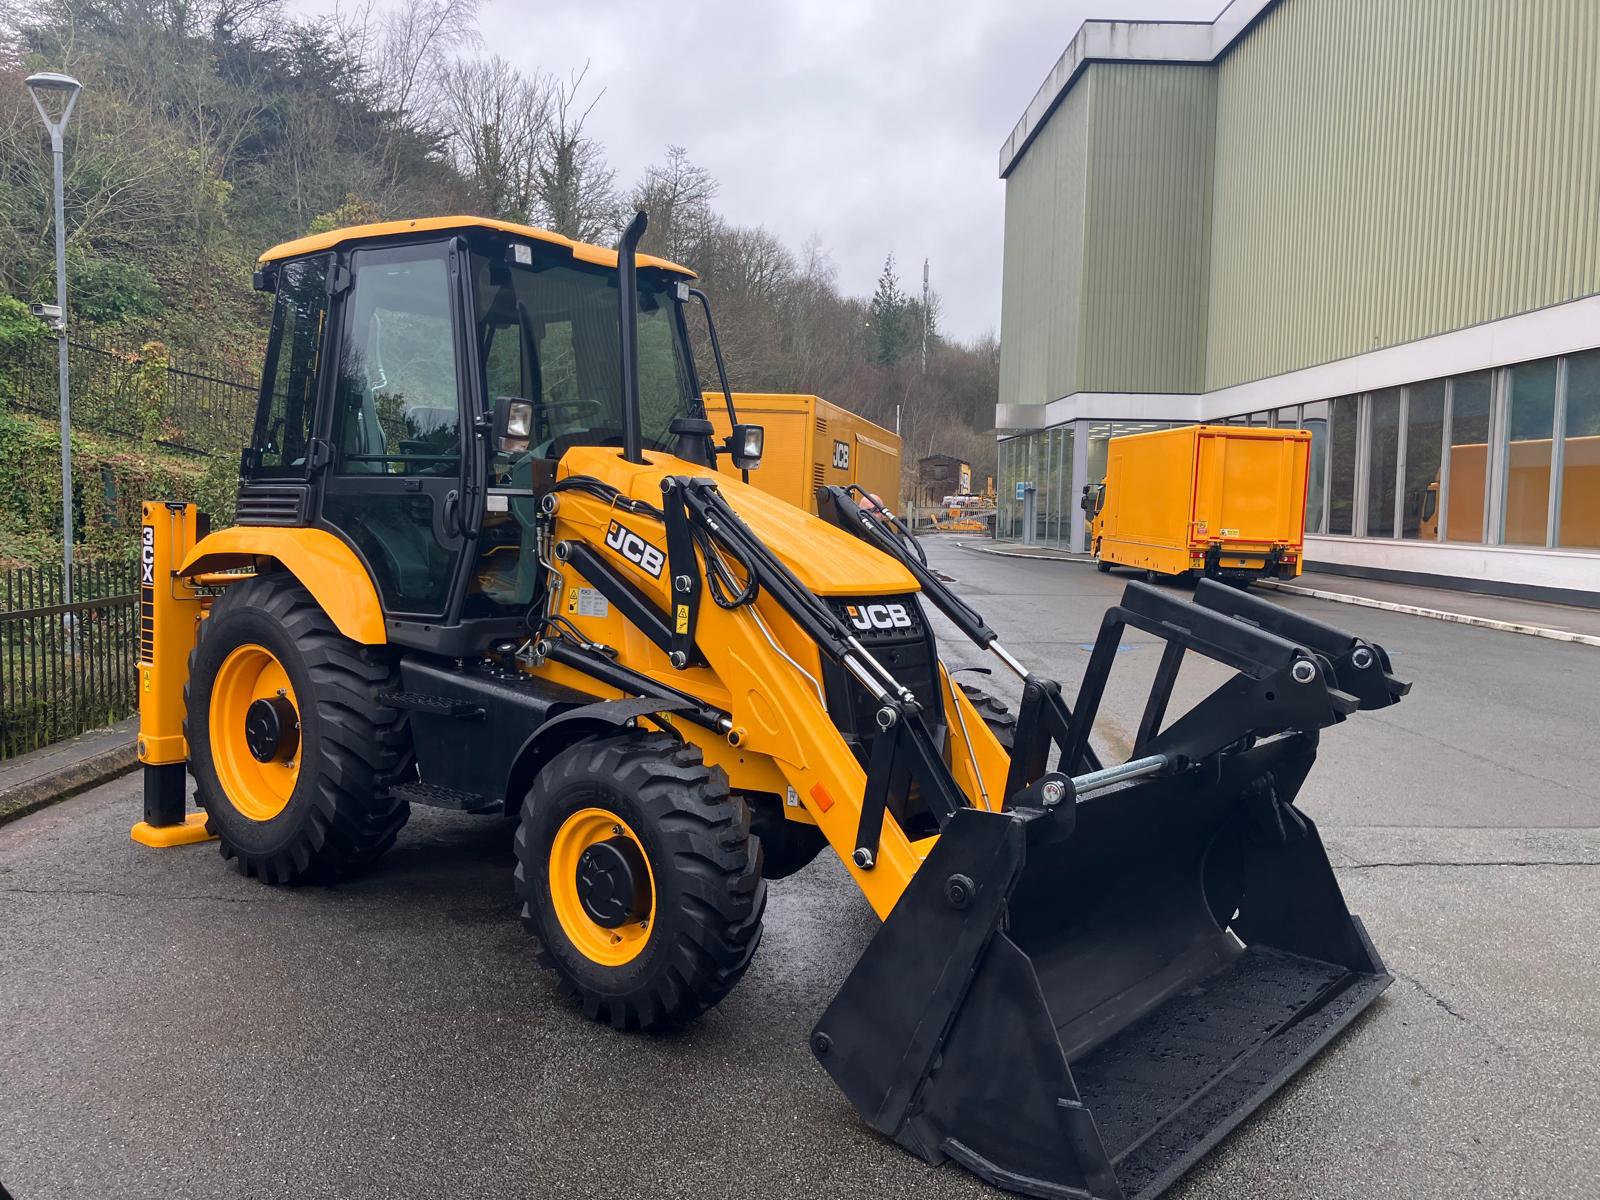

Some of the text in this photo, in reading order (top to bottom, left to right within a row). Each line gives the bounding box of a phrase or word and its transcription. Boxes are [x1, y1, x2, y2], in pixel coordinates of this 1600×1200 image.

[833, 442, 849, 468] JCB
[142, 527, 154, 582] 3CX
[606, 527, 664, 576] JCB
[850, 604, 912, 630] JCB
